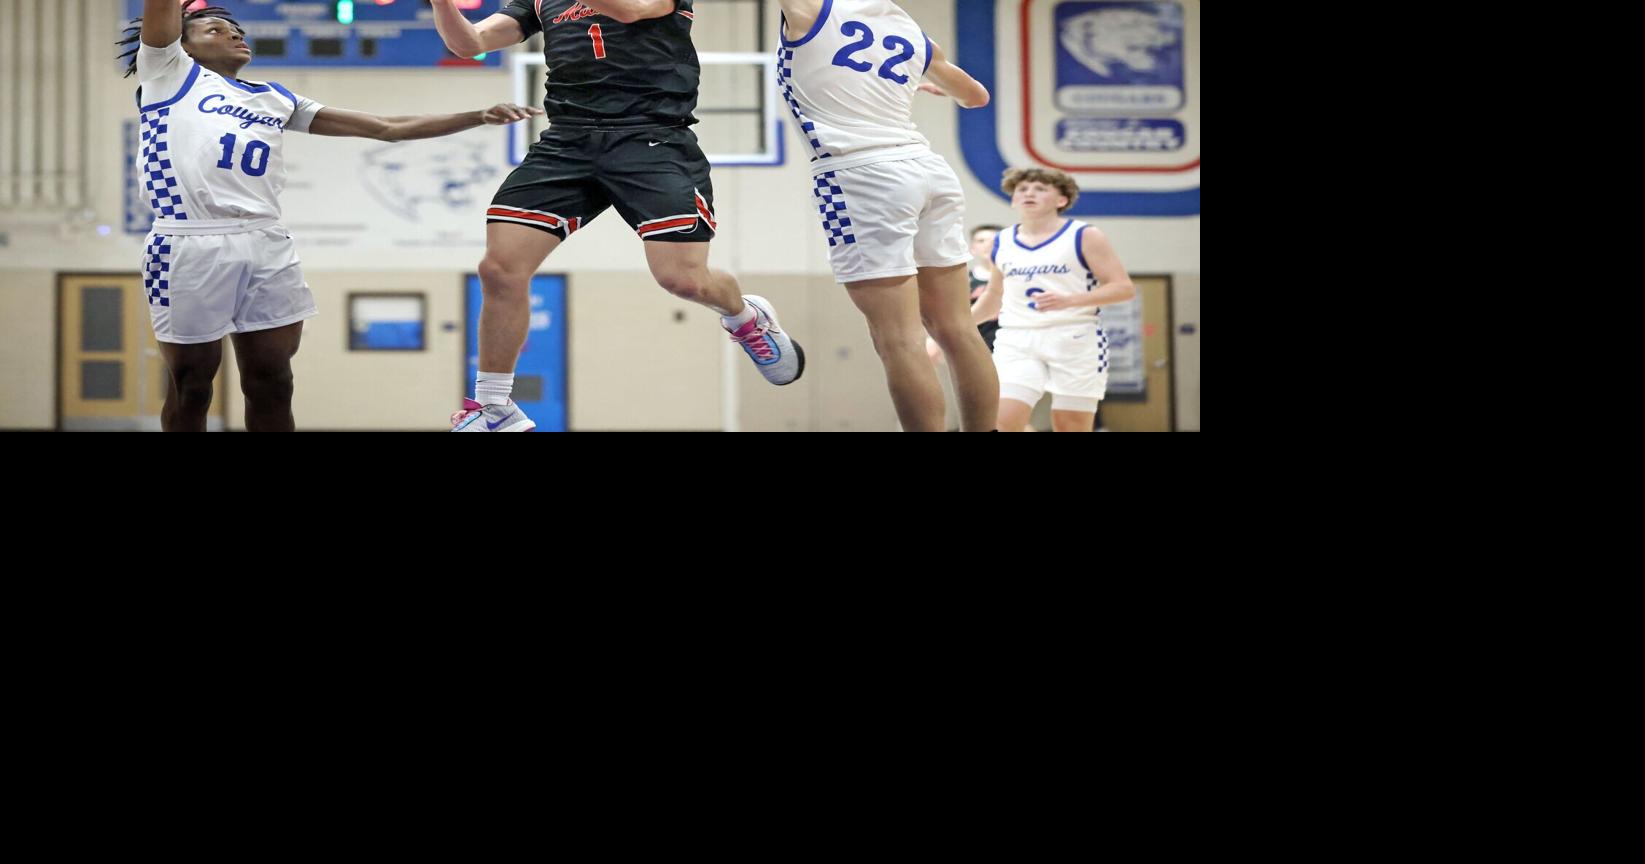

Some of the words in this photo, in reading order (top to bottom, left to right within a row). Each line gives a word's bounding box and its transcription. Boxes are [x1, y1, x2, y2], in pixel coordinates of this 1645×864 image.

[588, 23, 606, 59] 1
[832, 21, 915, 84] 22
[216, 132, 271, 176] 10
